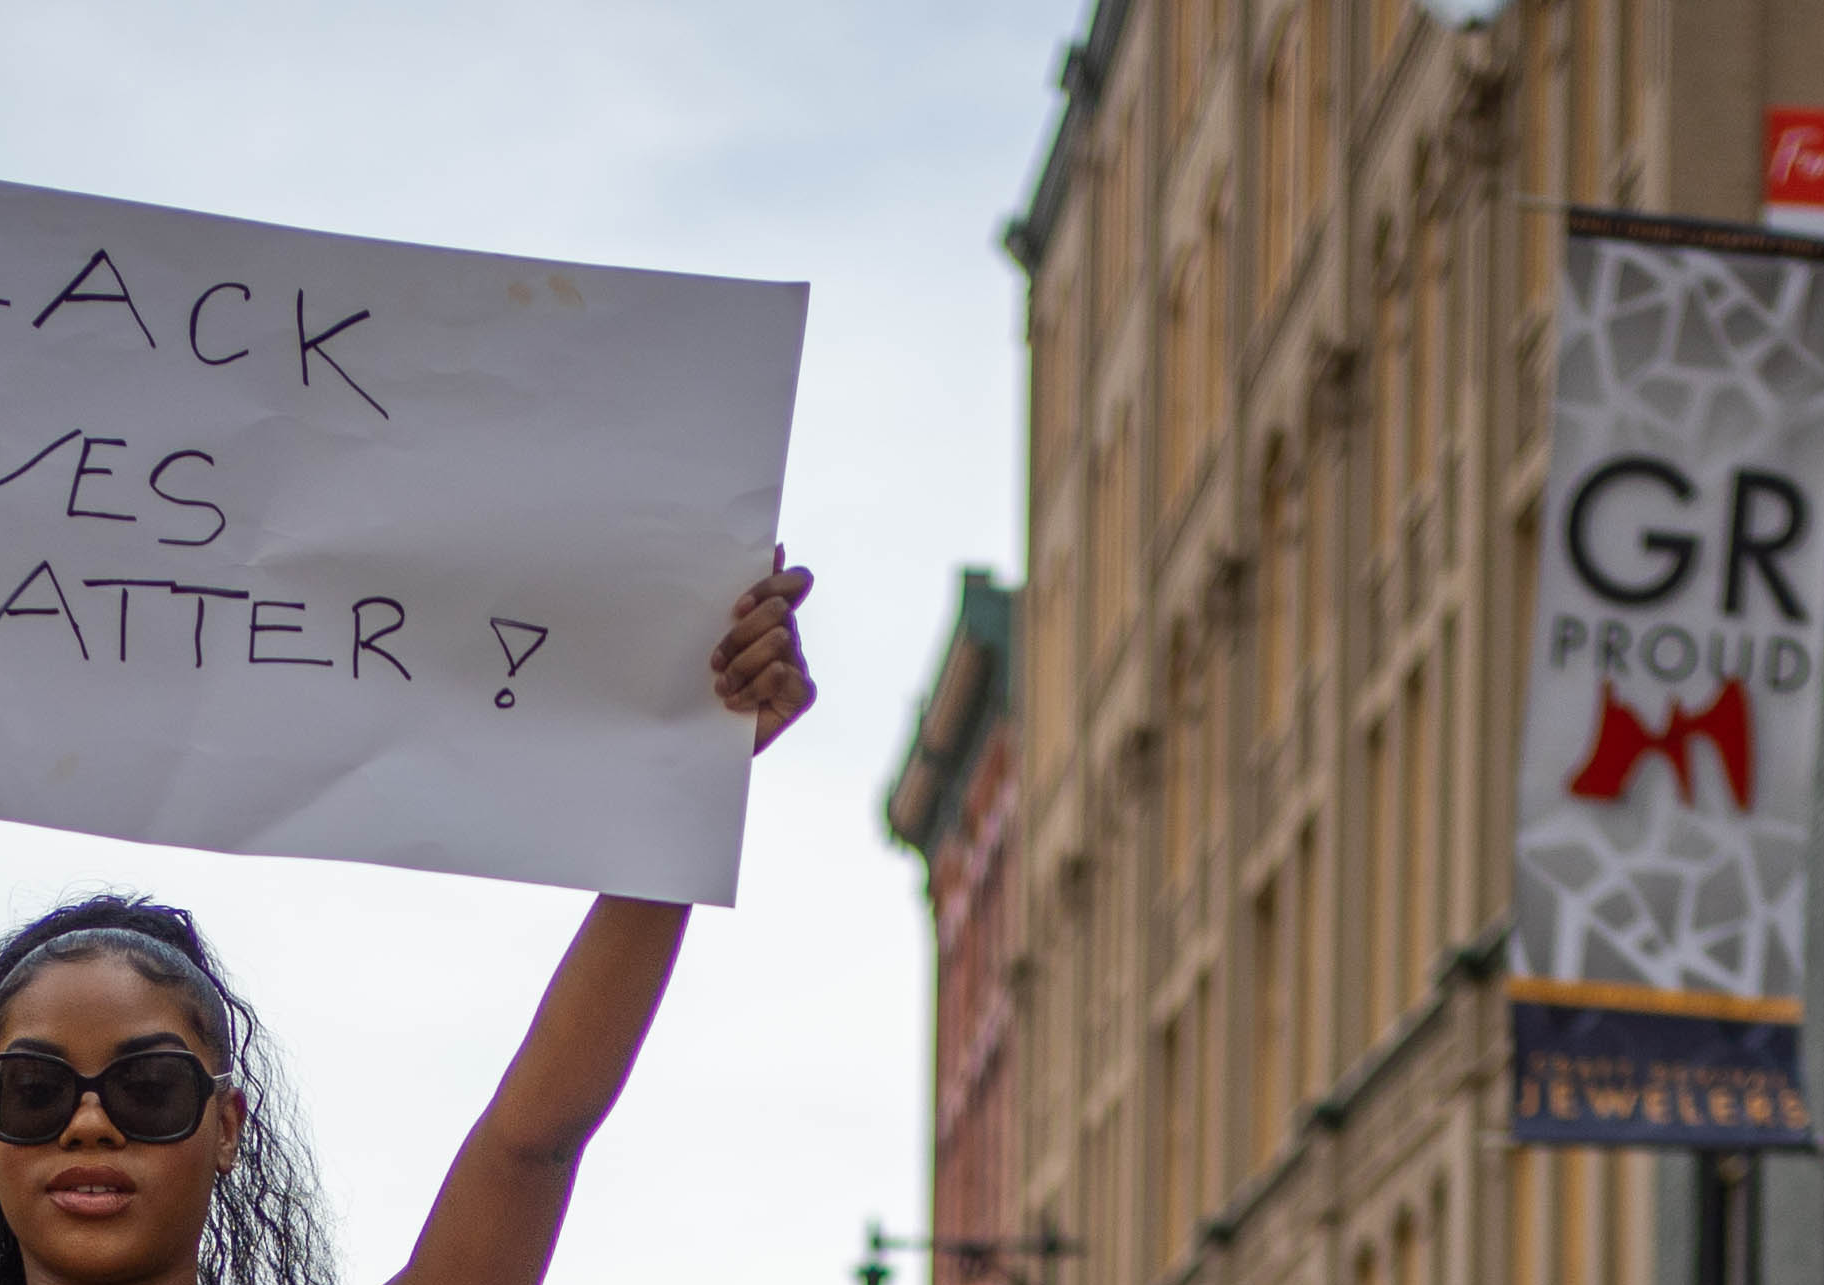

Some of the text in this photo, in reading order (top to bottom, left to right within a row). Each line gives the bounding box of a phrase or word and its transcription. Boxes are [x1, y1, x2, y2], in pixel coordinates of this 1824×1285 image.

[1563, 453, 1811, 626] GR
[1549, 613, 1812, 694] PROUD
[1518, 1075, 1810, 1131] JEWELERS
